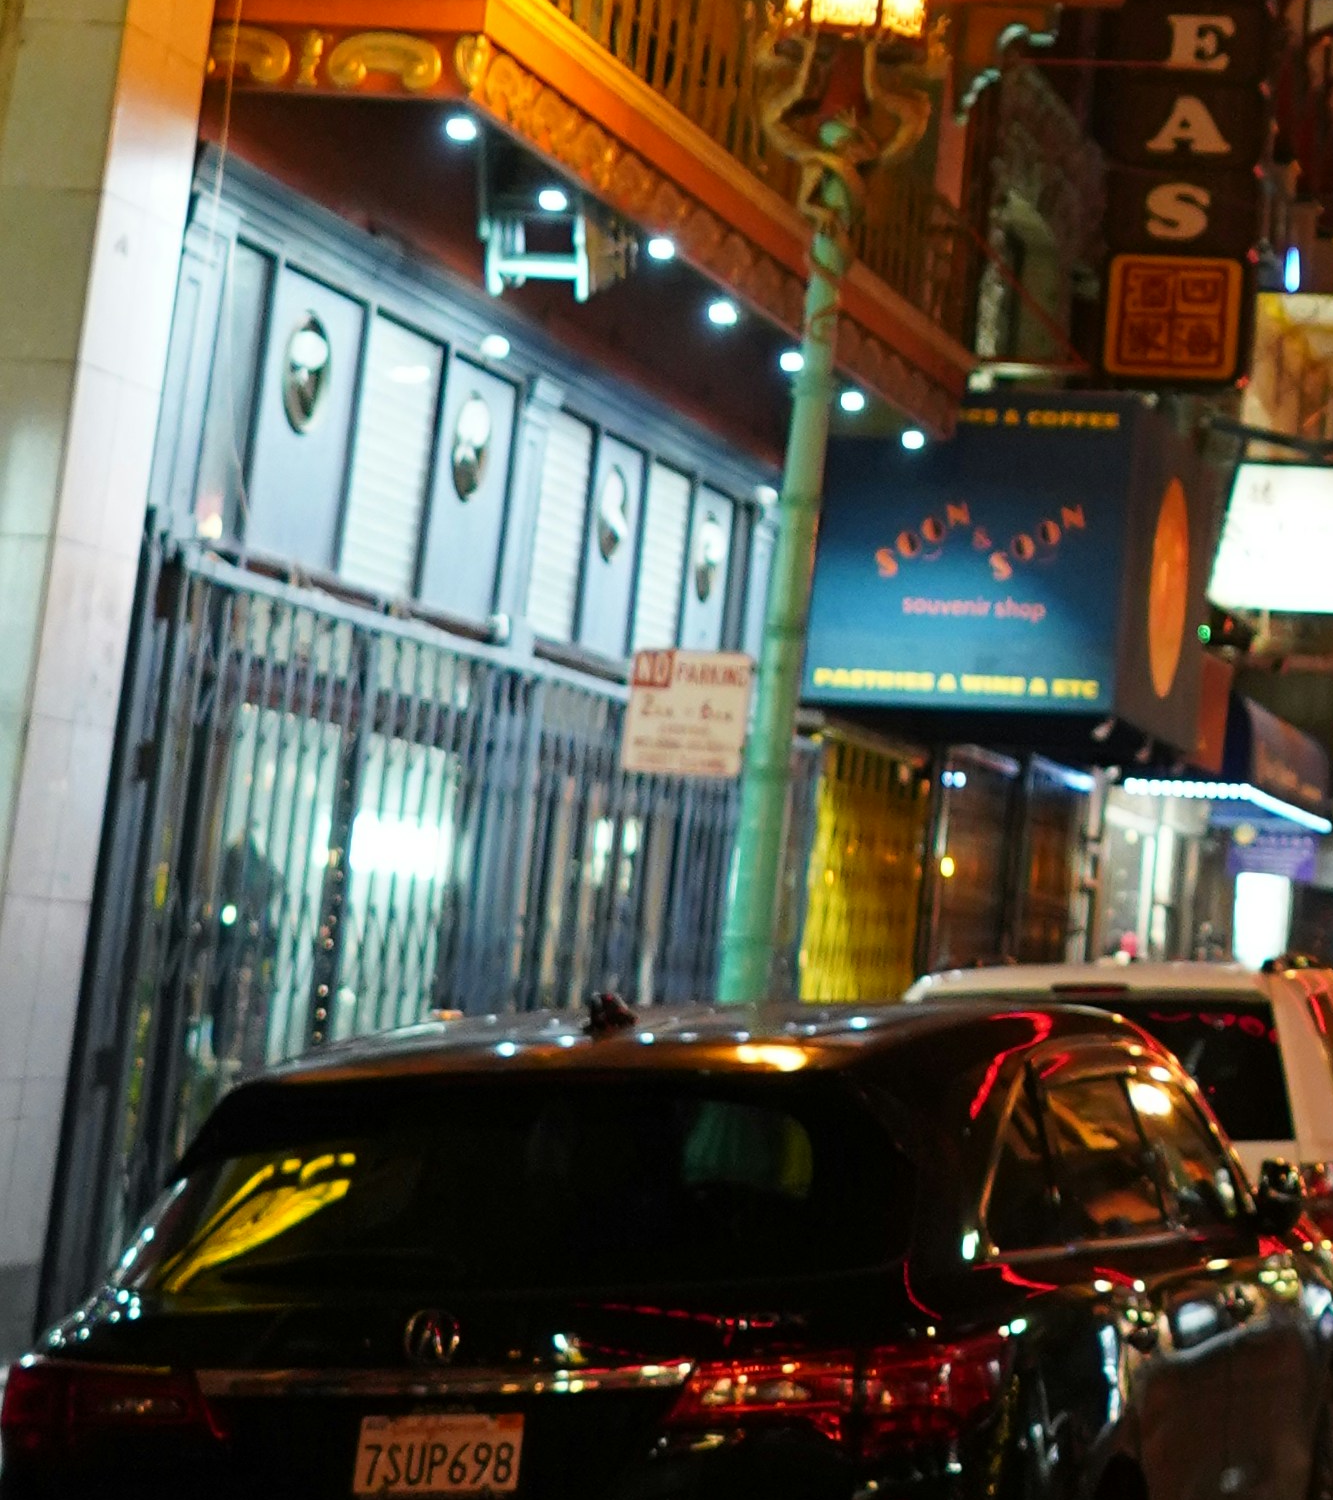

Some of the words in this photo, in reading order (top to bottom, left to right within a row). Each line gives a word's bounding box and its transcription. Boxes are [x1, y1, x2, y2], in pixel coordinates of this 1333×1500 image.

[874, 501, 971, 579] SOON
[988, 503, 1087, 582] SOON
[902, 596, 992, 618] souvenir
[994, 595, 1048, 624] shop
[636, 650, 671, 683] NO
[676, 662, 749, 687] PARKING
[365, 1441, 514, 1487] 7SUP698
